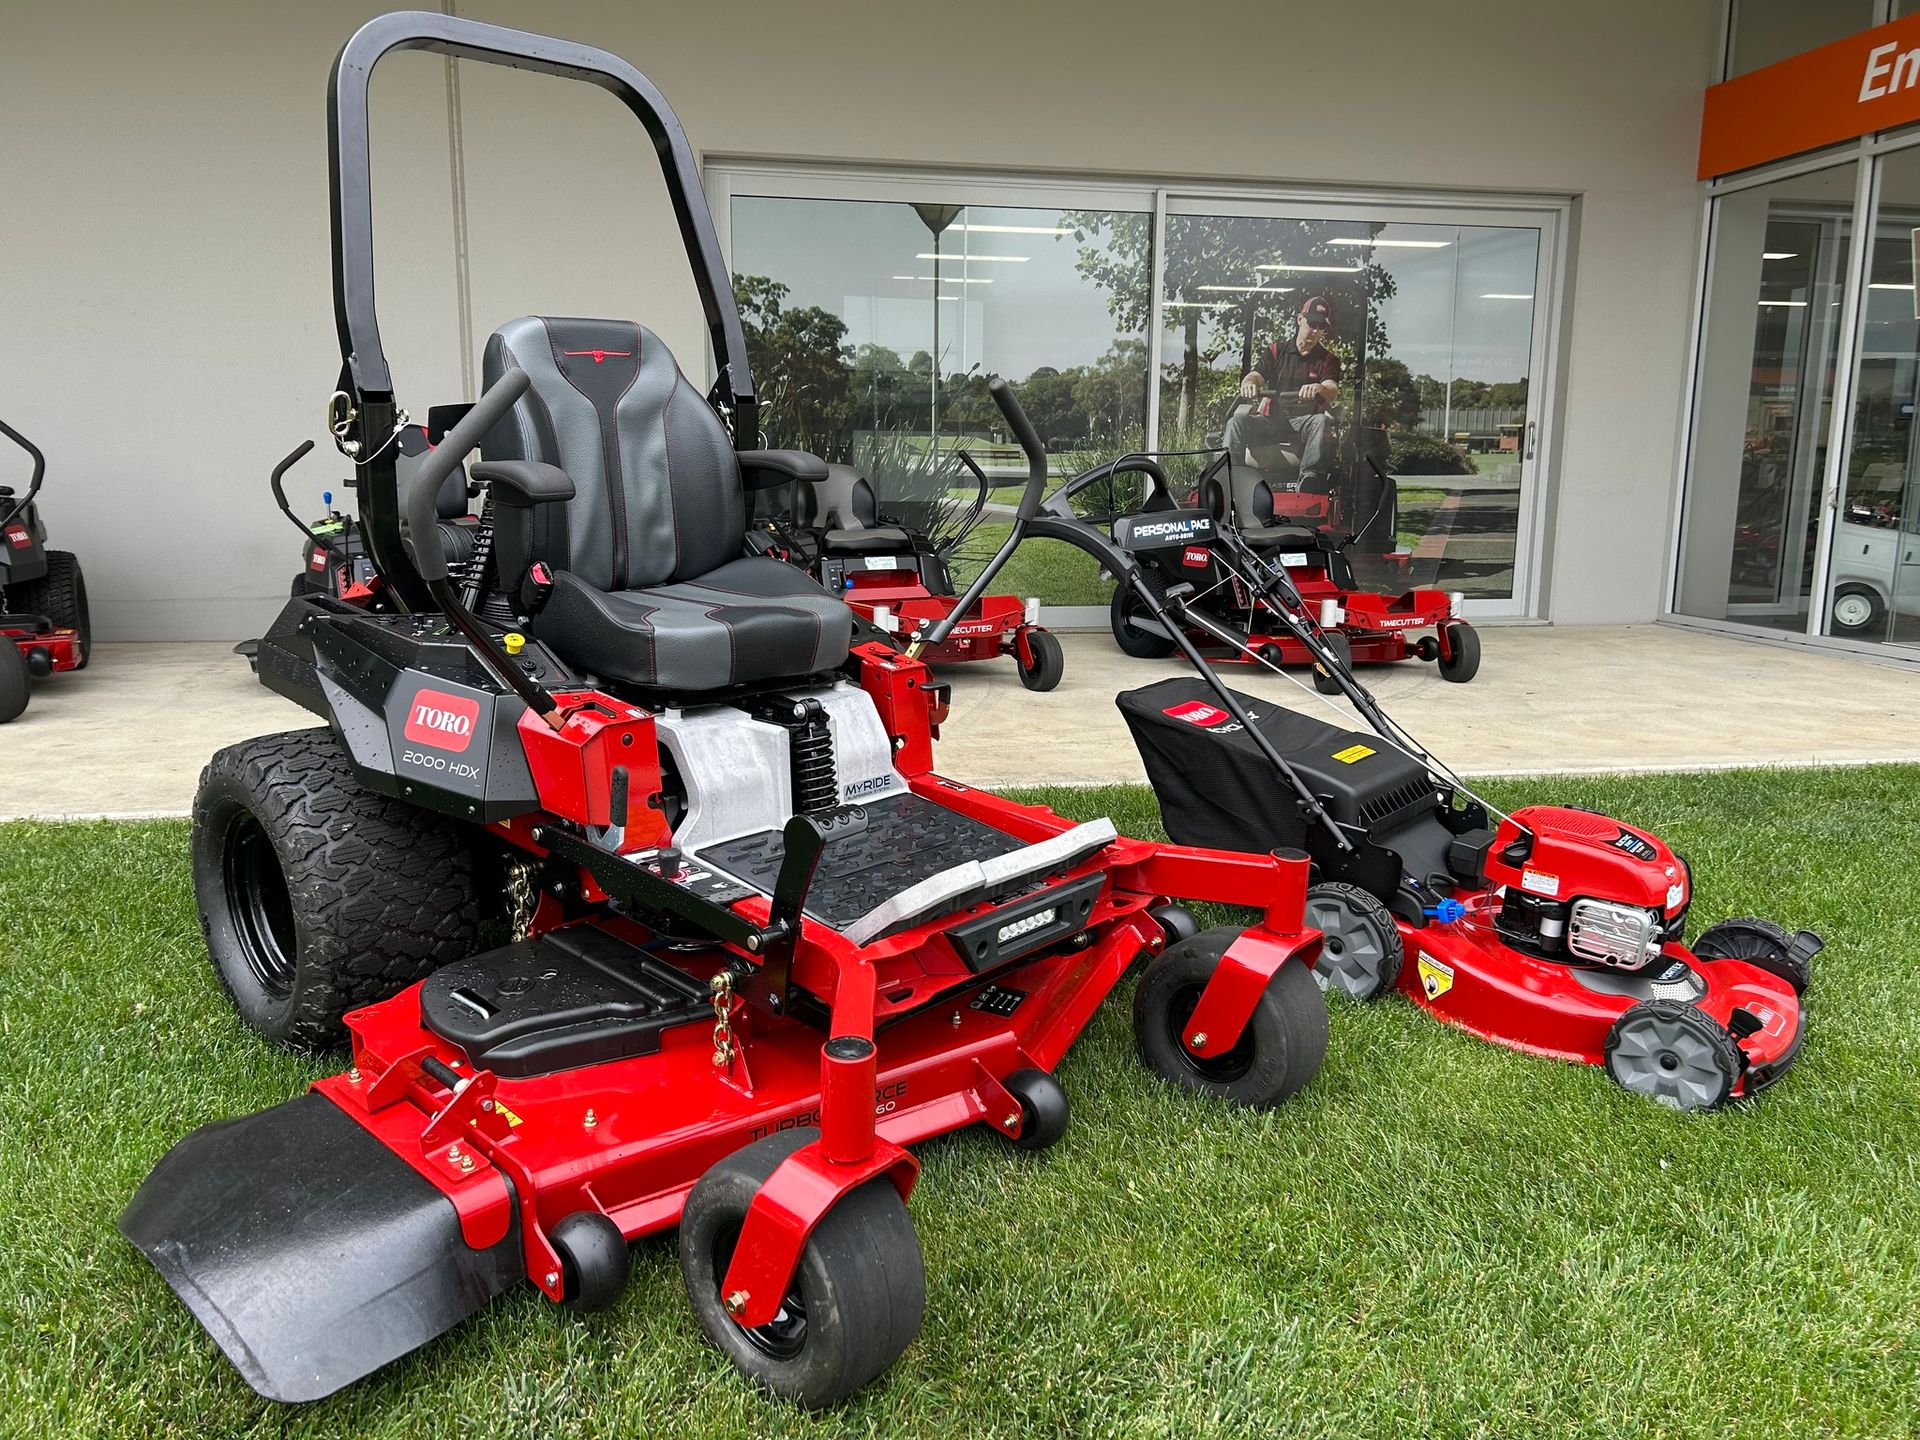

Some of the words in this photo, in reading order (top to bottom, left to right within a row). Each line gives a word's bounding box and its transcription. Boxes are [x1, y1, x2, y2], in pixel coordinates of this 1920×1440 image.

[1133, 521, 1189, 538] PERSONAL
[1191, 519, 1210, 531] PACE
[1164, 532, 1194, 542] AUTO-DRIVE
[1185, 552, 1208, 562] TORO
[1379, 617, 1425, 628] TIMECUTTER
[415, 705, 470, 736] TORO
[1173, 707, 1218, 723] TORO
[402, 750, 446, 771] 2000
[448, 761, 480, 780] HDX
[875, 1101, 896, 1115] 60
